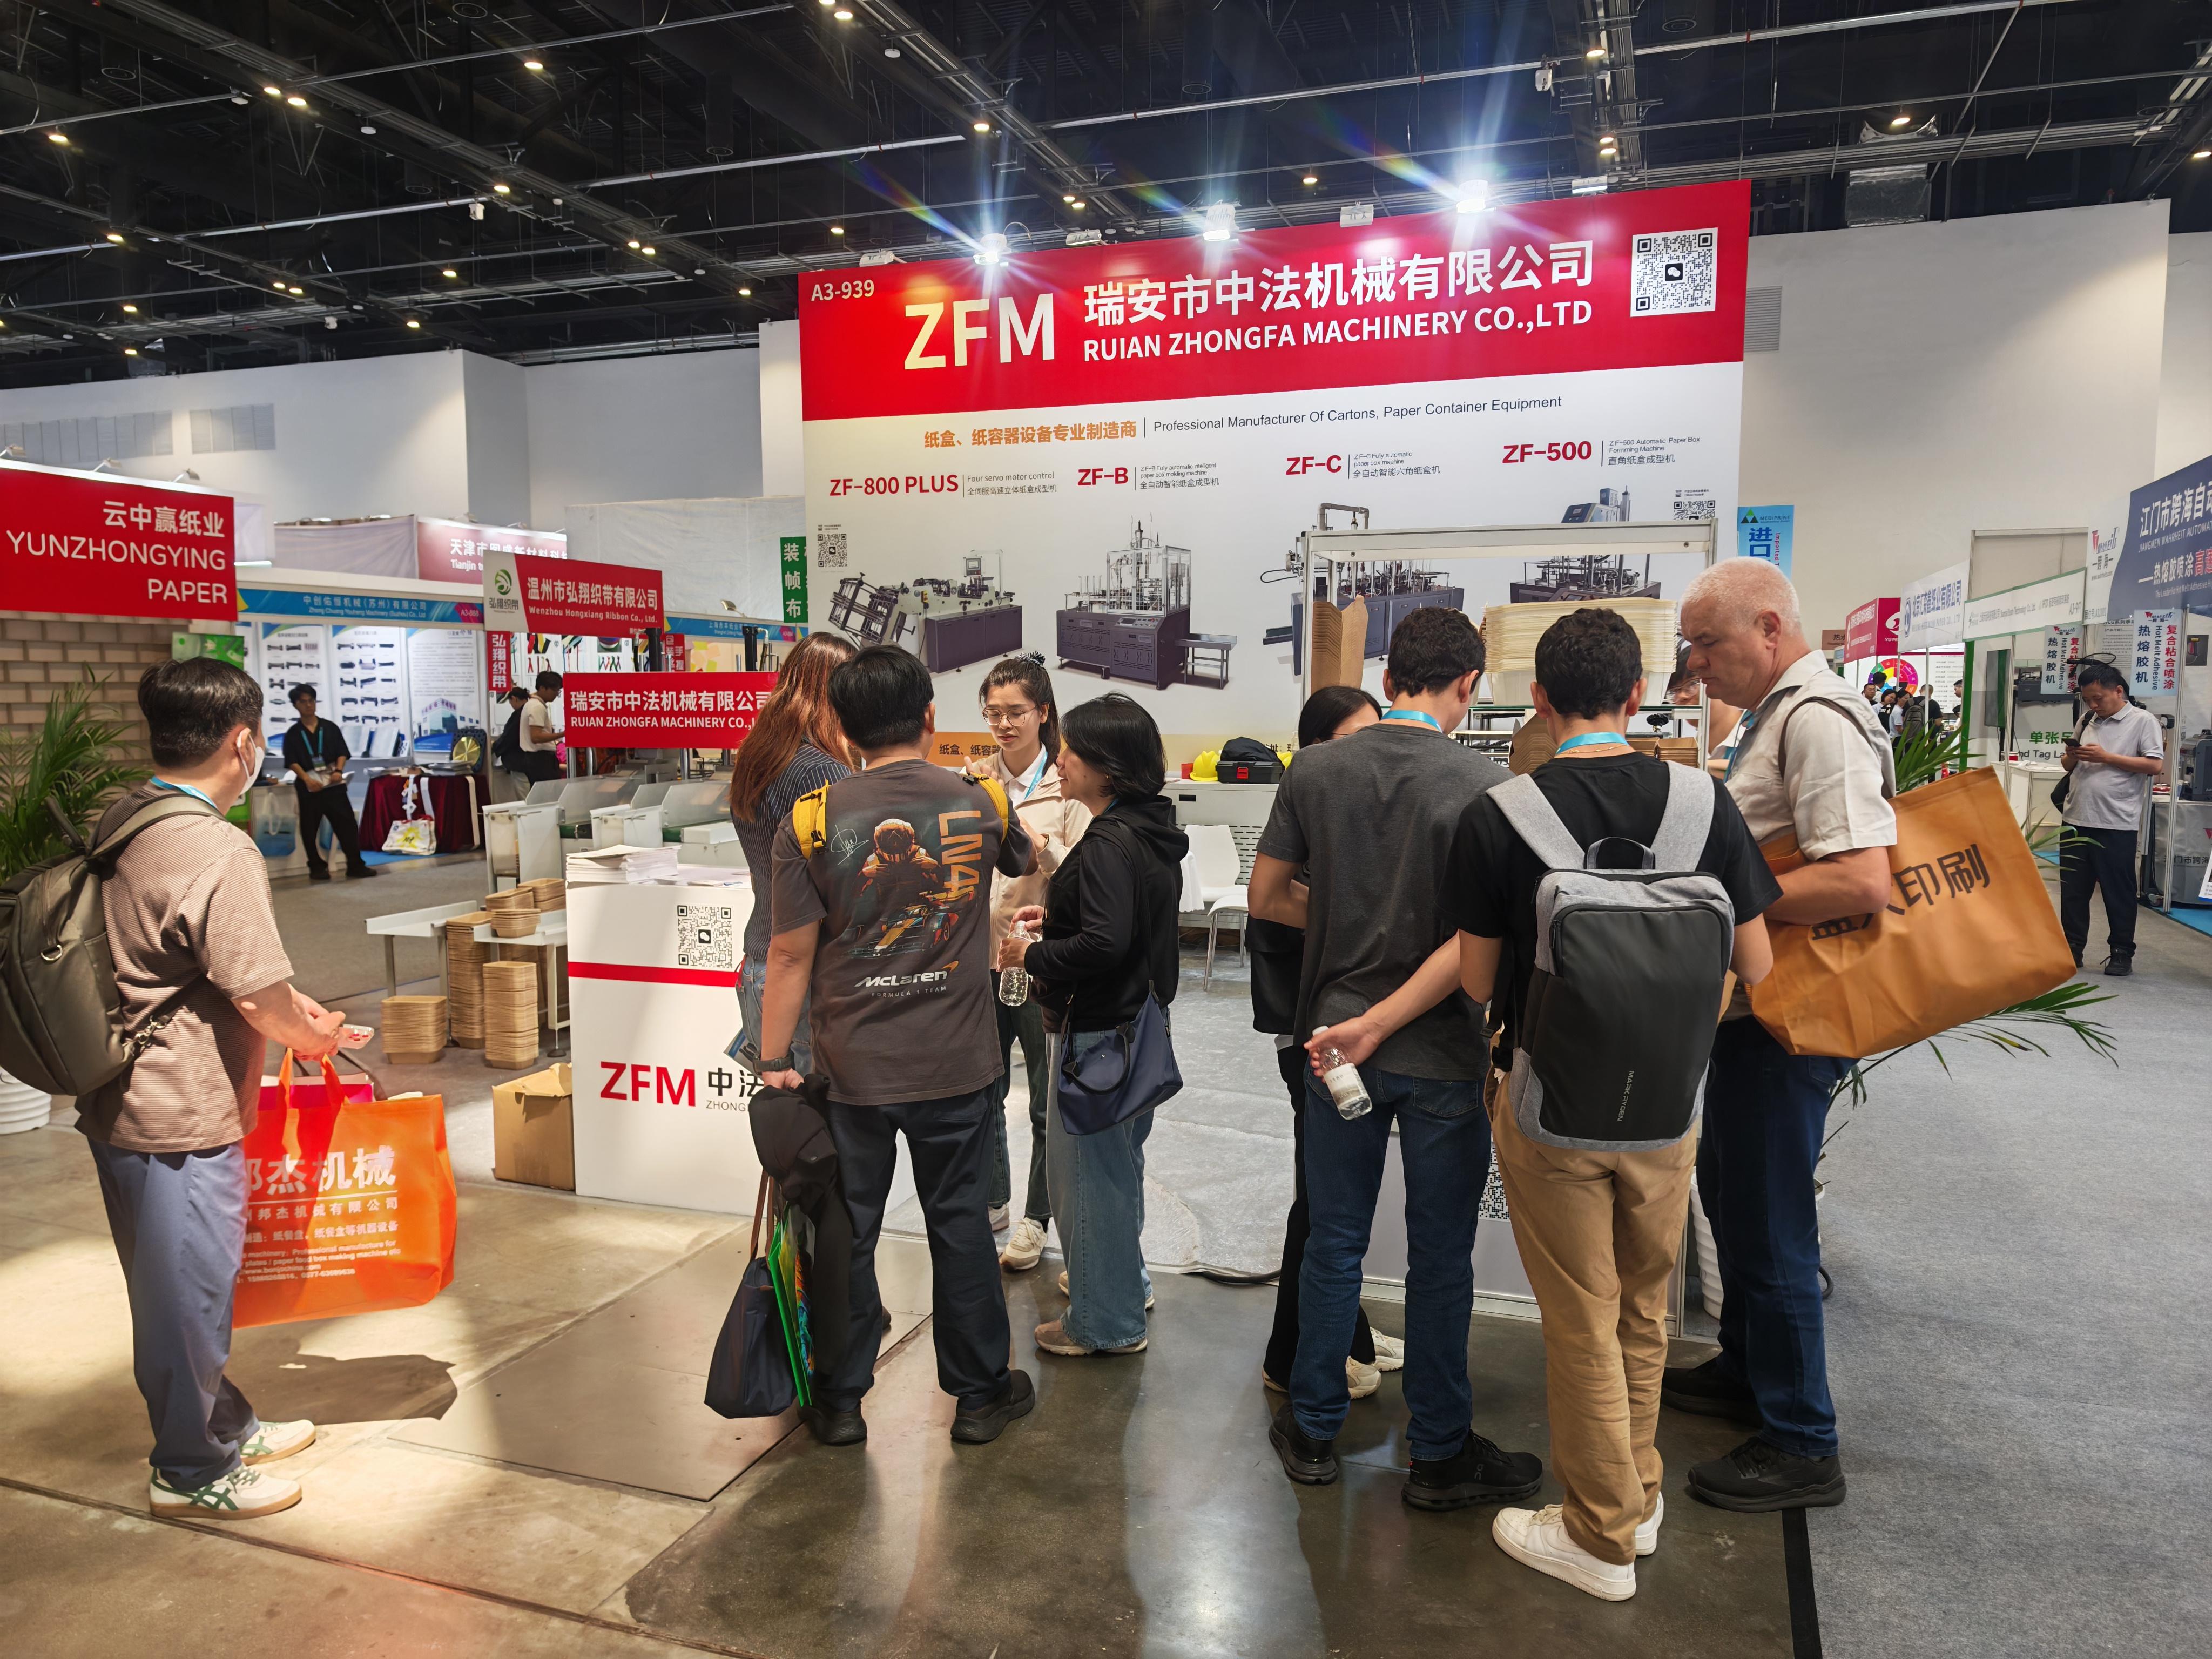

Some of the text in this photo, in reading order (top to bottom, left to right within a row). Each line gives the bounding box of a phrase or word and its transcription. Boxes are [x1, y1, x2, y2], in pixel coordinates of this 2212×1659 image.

[811, 279, 874, 301] A3-939
[1084, 240, 1593, 326] 瑞安市中法机械有限公司
[905, 293, 1055, 370] ZFM
[1084, 300, 1592, 361] RUIAN ZHONGFA MACHINERY CO.,LTD
[1154, 396, 1562, 432] Professional Manufacturer Of Cartons, Paper Container Equipment
[924, 420, 1137, 448] 纸盒、纸容器设备专业制造商
[1502, 441, 1592, 463] ZF-500
[1608, 454, 1675, 466] 直角纸盒成型机
[1028, 471, 1054, 480] control
[1077, 467, 1129, 486] ZF-B
[1285, 455, 1342, 475] ZF-C
[1353, 466, 1440, 478] 全自动智能六角纸盒机
[830, 474, 959, 496] ZF-800 PLUS
[967, 484, 1057, 496] 全伺服高速立体纸盒成型机
[1139, 478, 1219, 489] 全自动智能纸盒成型机
[103, 501, 224, 538] 云中赢纸业
[6, 530, 226, 571] YUNZHONGYING
[2139, 538, 2160, 553] JIANGMEN
[450, 559, 476, 571] Tianjin
[148, 579, 227, 604] PAPER
[784, 543, 802, 618] 装帧布
[527, 577, 658, 611] 温州市弘翔织带有限公司
[529, 606, 563, 616] Wenzhou
[565, 609, 604, 621] Hongxiang
[605, 611, 629, 621] Ribbon
[2135, 625, 2151, 683] 热熔胶机
[2154, 640, 2162, 656] Melt
[2163, 624, 2177, 690] 复合粘合喷涂
[492, 634, 507, 688] 弘翔织带
[2046, 637, 2059, 684] 热熔胶机
[2152, 657, 2161, 691] Adhesive
[571, 716, 603, 727] RUIAN
[606, 717, 658, 728] ZHONGFA
[661, 717, 725, 728] MACHINERY
[2033, 750, 2051, 760] Tag
[2054, 750, 2066, 759] La
[938, 811, 983, 893] LN4
[854, 970, 948, 988] McLaren
[925, 986, 946, 994] TEAM
[600, 1061, 696, 1107] ZFM
[1624, 1070, 1635, 1095] MARK
[706, 1100, 750, 1112] ZHONG
[247, 1197, 398, 1222] 邦杰机械有限公司
